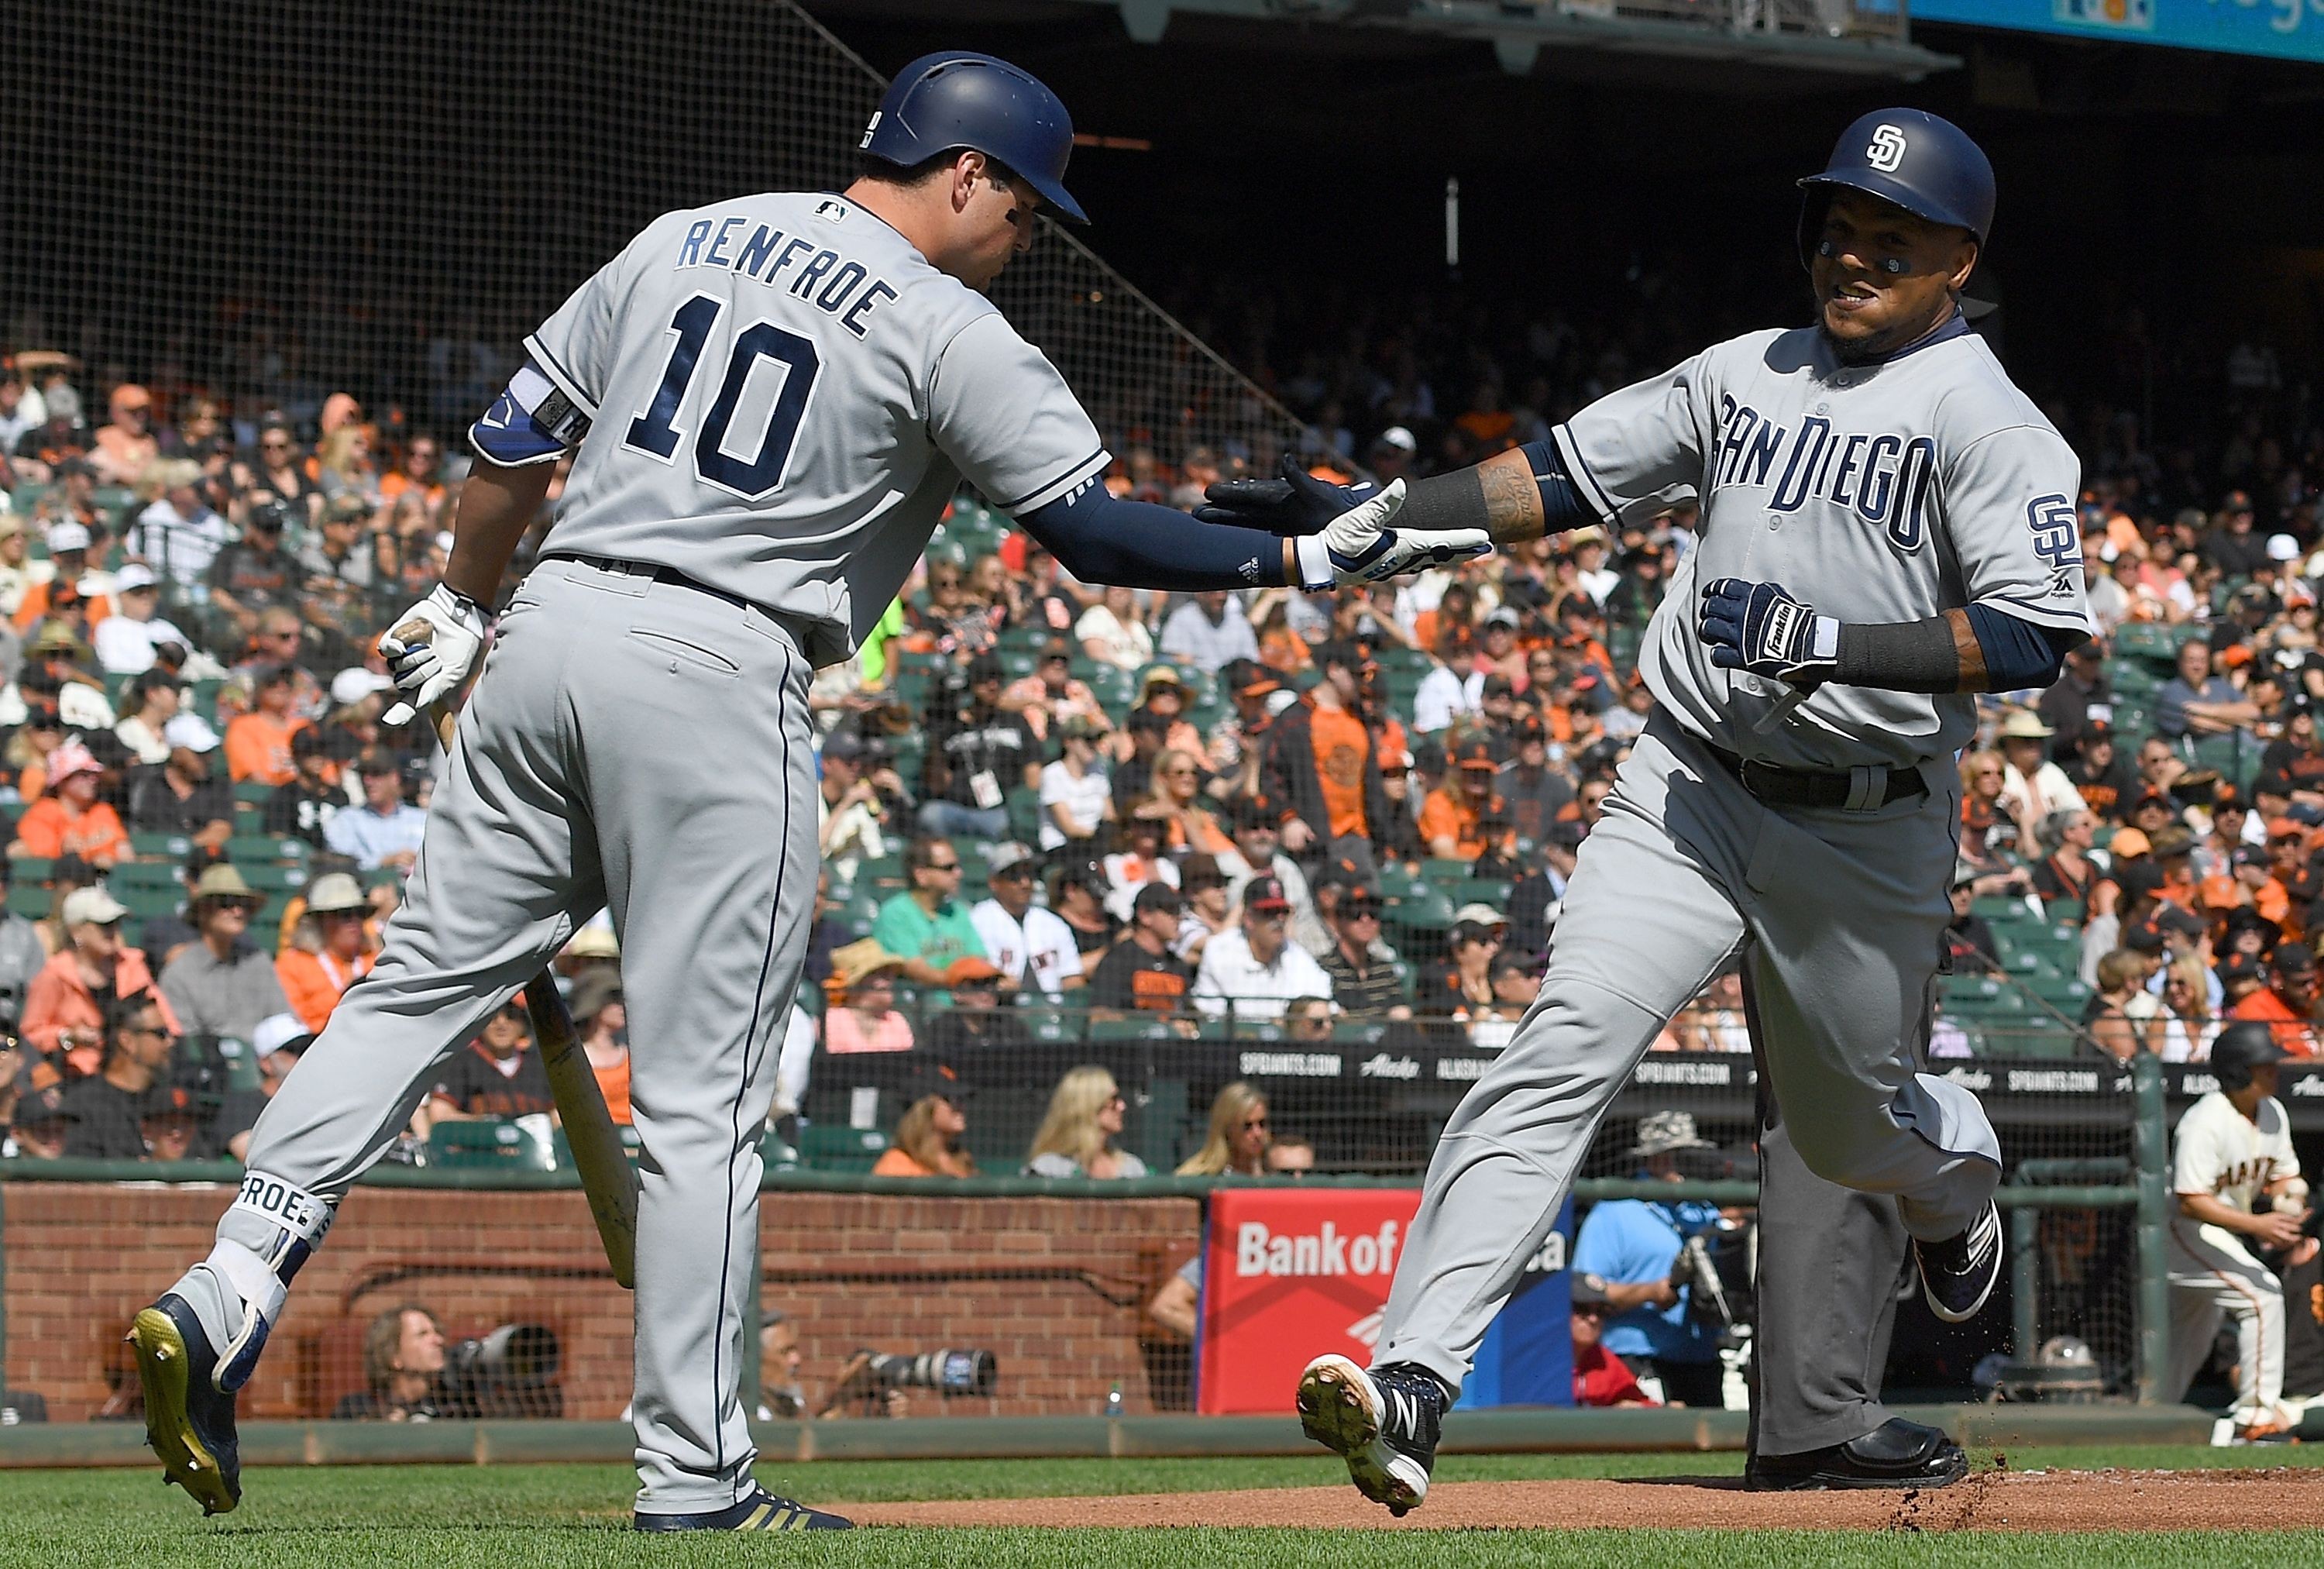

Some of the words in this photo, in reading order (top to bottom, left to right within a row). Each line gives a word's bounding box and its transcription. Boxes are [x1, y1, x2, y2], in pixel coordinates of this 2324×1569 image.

[1866, 124, 1907, 173] SD
[674, 216, 902, 341] RENFROE
[621, 289, 825, 503] 10
[1712, 391, 1790, 493] SAN
[1763, 411, 1937, 552] DIEGO
[2024, 491, 2085, 571] SD
[1766, 605, 1792, 657] Franklin
[1436, 1057, 1494, 1080] ALASK
[1237, 1221, 1347, 1277] Bank
[1350, 1220, 1397, 1275] of
